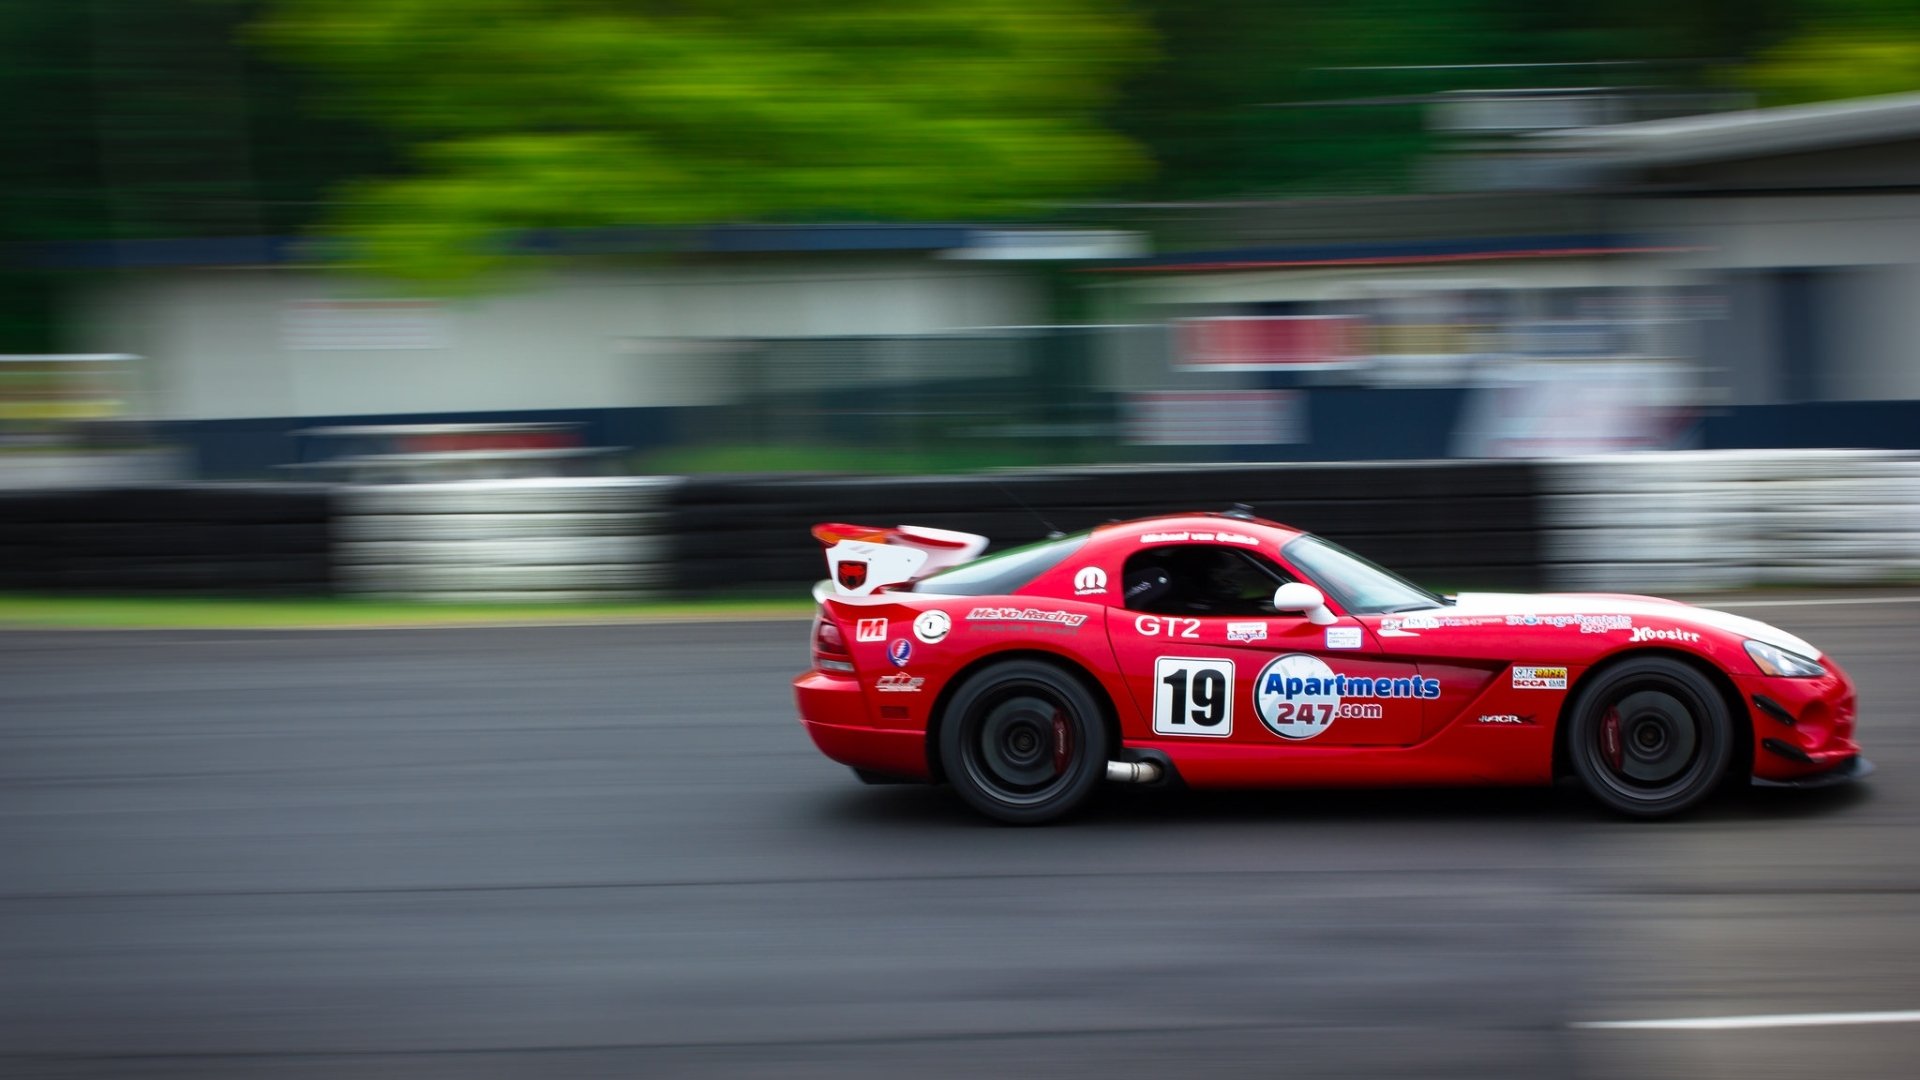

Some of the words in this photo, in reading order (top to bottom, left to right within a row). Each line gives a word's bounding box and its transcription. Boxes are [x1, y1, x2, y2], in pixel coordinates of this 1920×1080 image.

[1019, 608, 1088, 626] Racing
[1134, 615, 1200, 638] GT2
[1264, 672, 1441, 700] Apartments
[1163, 669, 1226, 727] 19
[1276, 703, 1334, 726] 247
